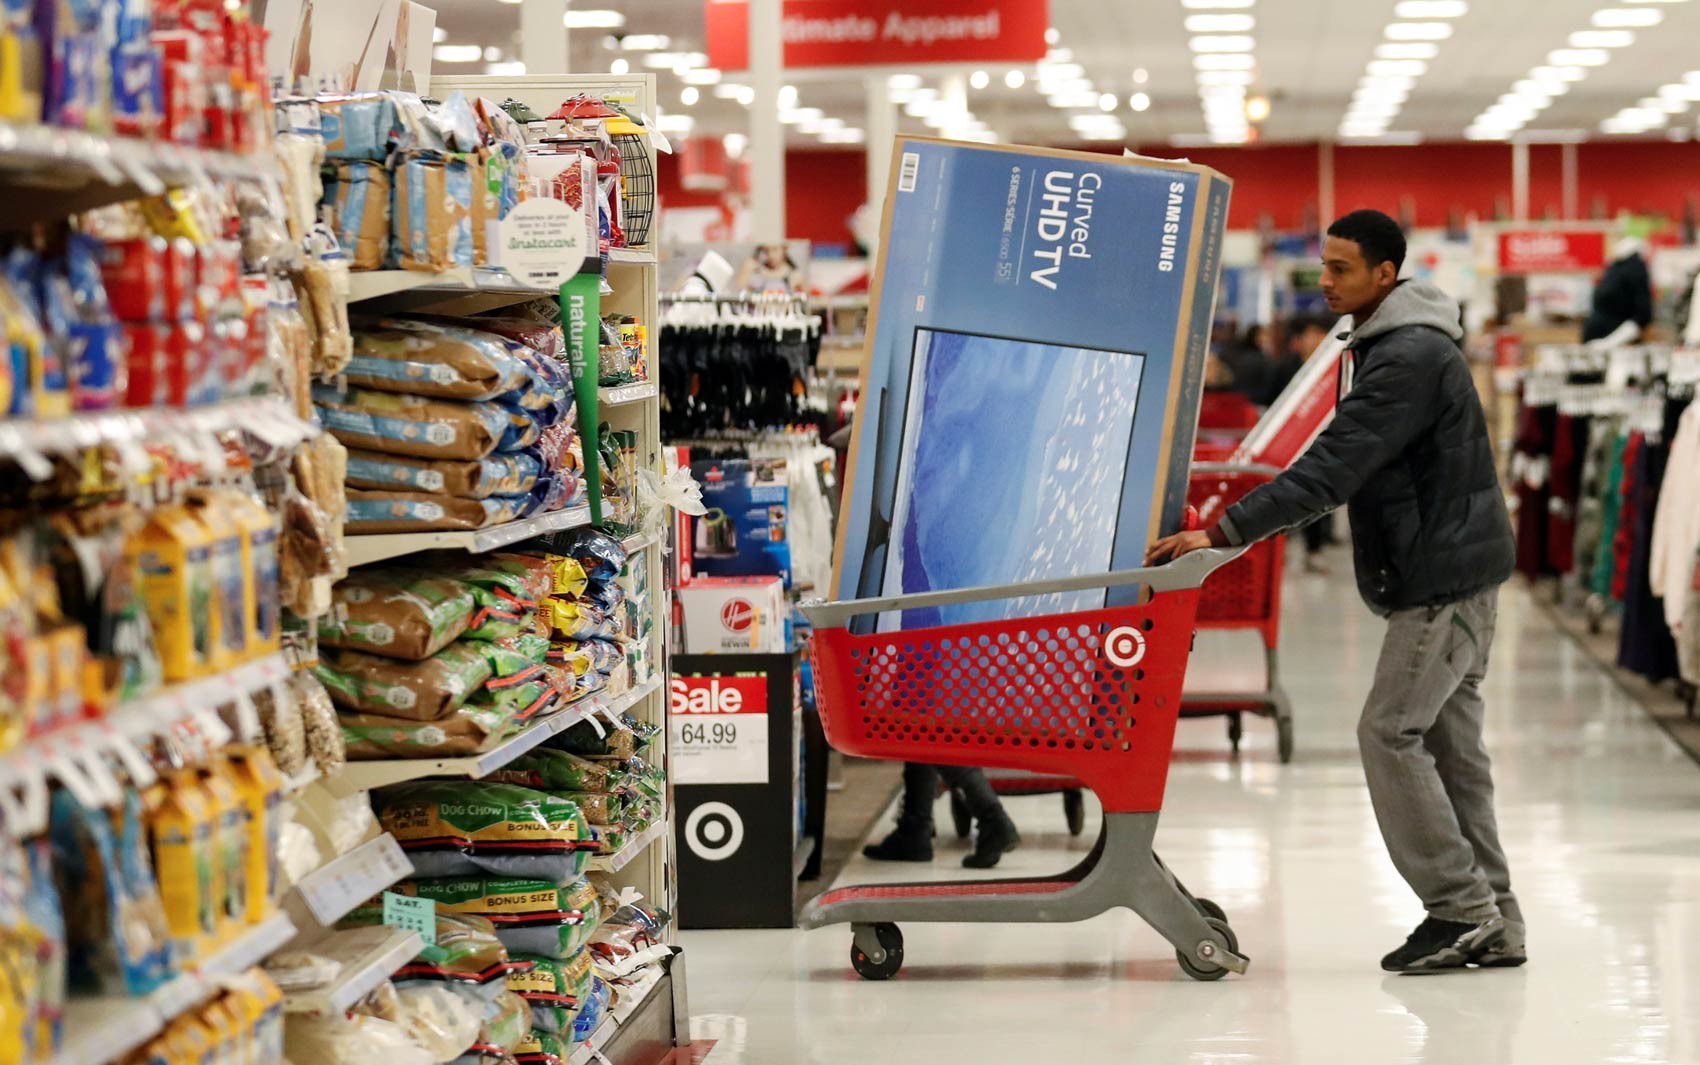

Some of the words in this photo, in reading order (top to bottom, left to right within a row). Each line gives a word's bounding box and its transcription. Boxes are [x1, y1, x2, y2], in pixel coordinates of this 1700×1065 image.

[882, 12, 998, 44] Apparel
[1037, 171, 1074, 242] UHD
[1069, 172, 1102, 258] Curved
[1158, 181, 1185, 272] SAMSUNG
[1030, 246, 1063, 290] TV
[570, 295, 588, 378] naturals
[721, 640, 750, 648] REWIN
[672, 679, 743, 714] Sale
[682, 722, 737, 744] 64.99
[441, 803, 464, 815] DOG
[467, 804, 502, 816] CHOW
[446, 881, 480, 894] CHOW
[487, 895, 527, 907] BONUS
[530, 892, 555, 902] SIZE
